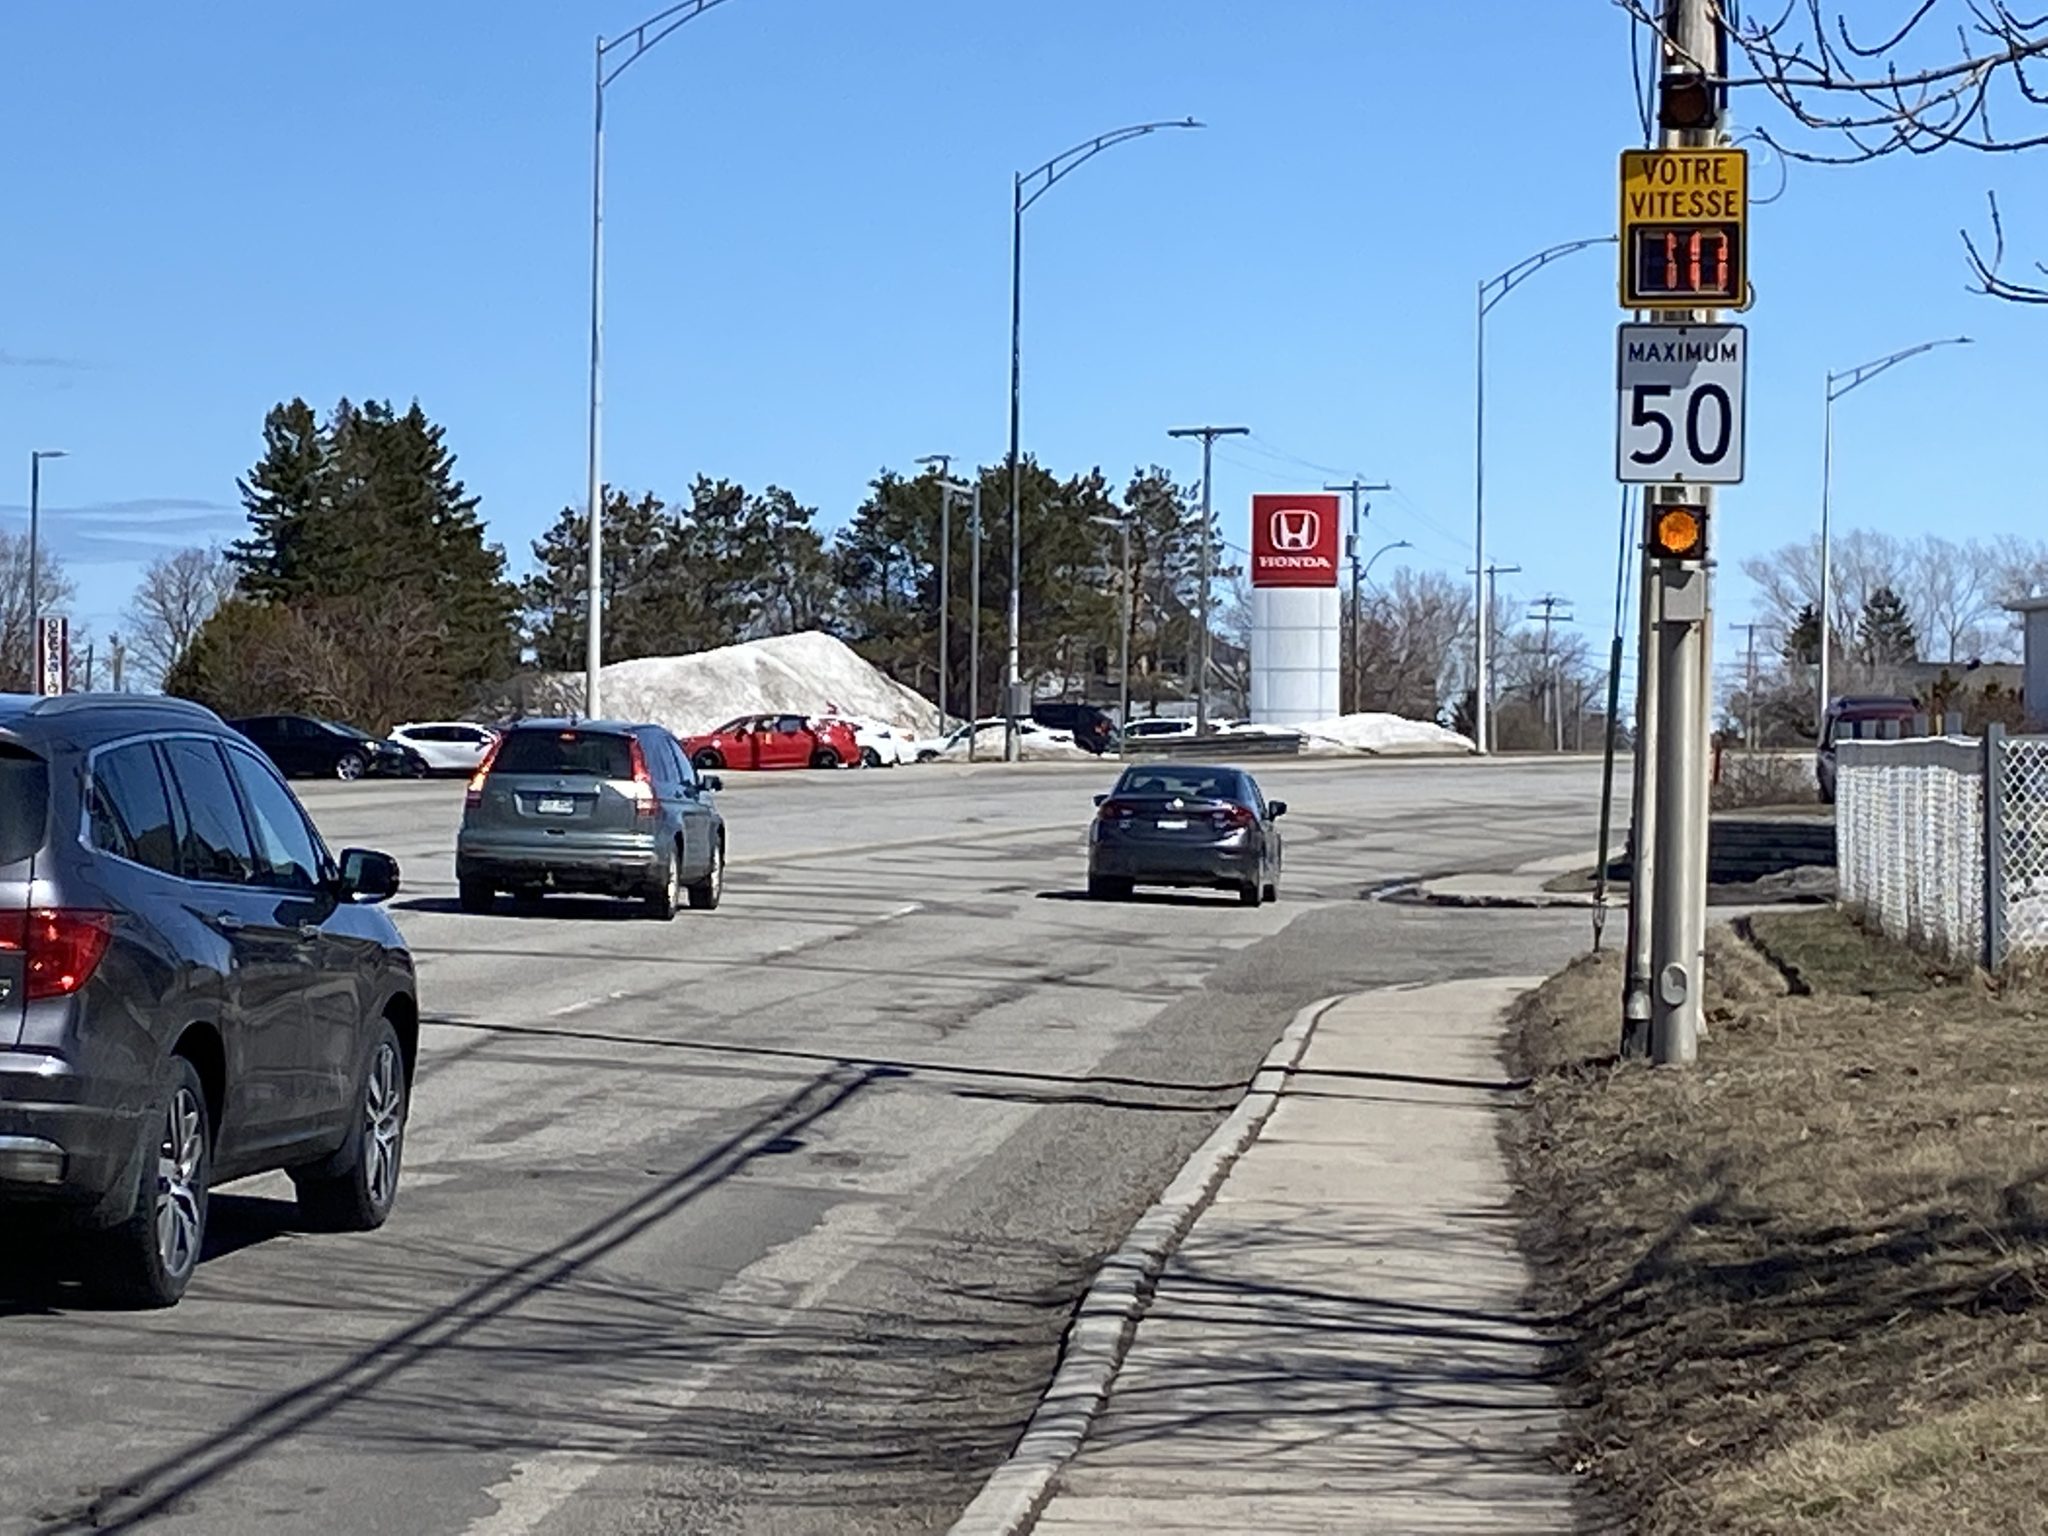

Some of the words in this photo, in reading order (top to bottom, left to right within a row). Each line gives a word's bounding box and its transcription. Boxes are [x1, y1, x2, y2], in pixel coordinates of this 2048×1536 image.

[1641, 157, 1728, 186] VOTRE
[1629, 190, 1739, 217] VITESSE
[1628, 342, 1738, 363] MAXIMUM
[1629, 382, 1733, 466] 50
[1259, 556, 1331, 569] HONDA
